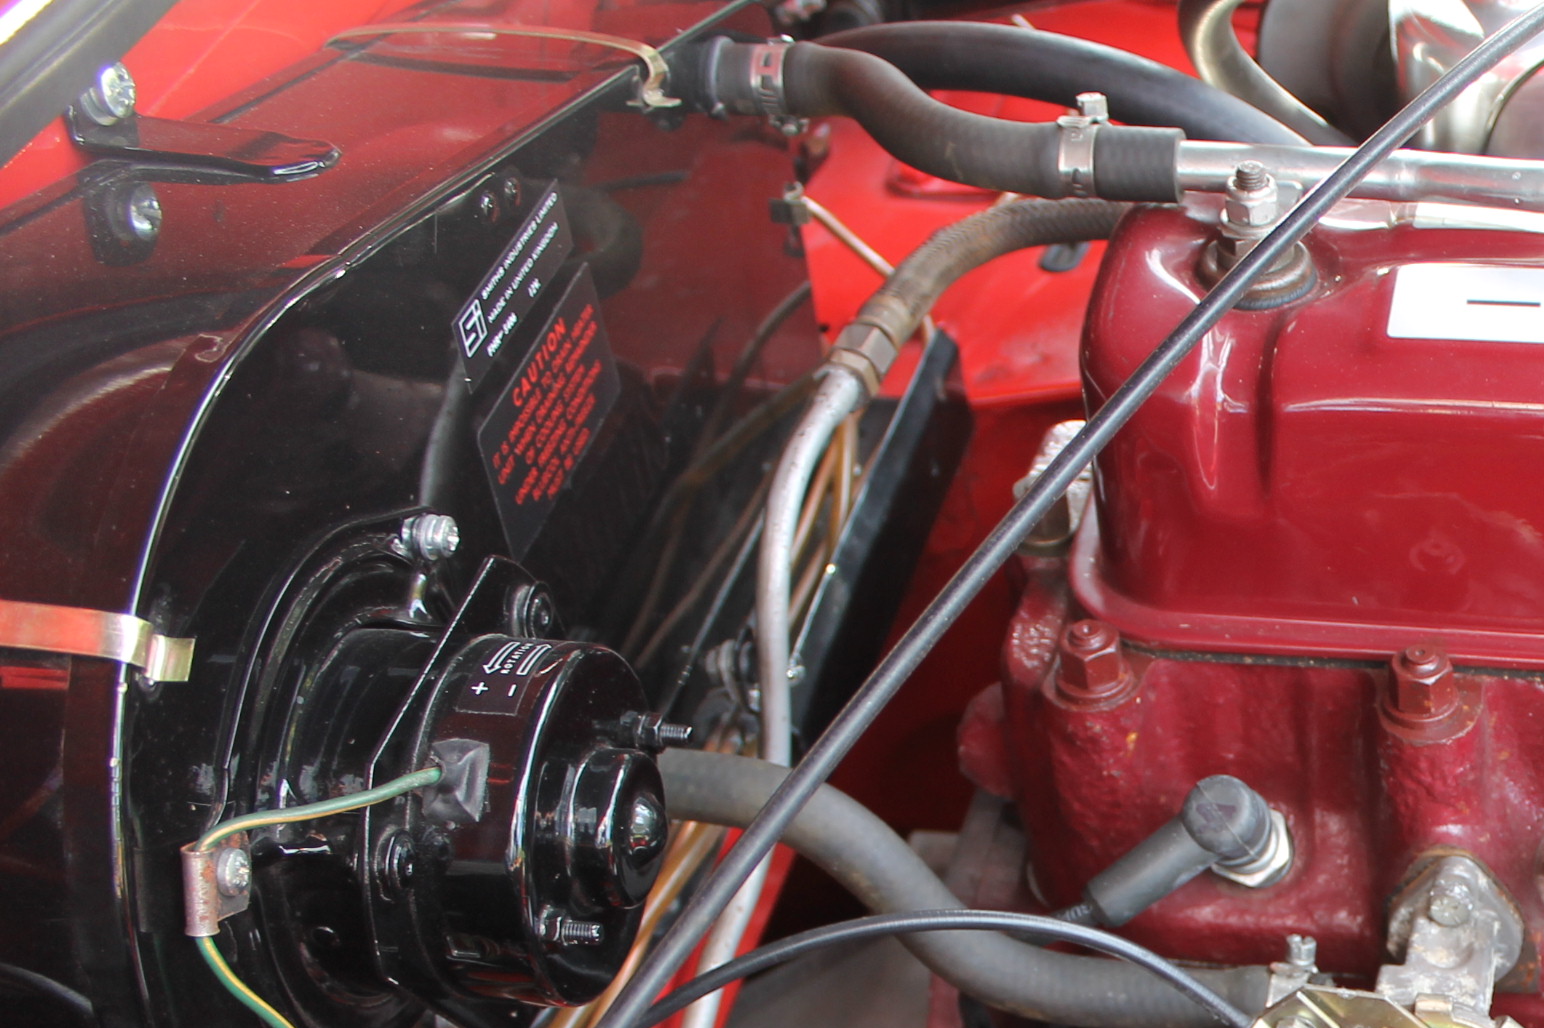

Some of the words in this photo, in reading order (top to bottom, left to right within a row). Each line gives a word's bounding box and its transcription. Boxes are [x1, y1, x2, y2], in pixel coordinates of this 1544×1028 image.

[481, 266, 506, 300] SMITHS
[503, 219, 538, 270] INDUSTRIES
[535, 192, 558, 224] LIMITED
[487, 297, 507, 323] MADE
[504, 286, 514, 300] IN
[511, 257, 534, 291] UNITED
[531, 221, 559, 262] KINGDOM
[512, 317, 567, 407] CAUTION
[500, 642, 534, 675] ROTATION
